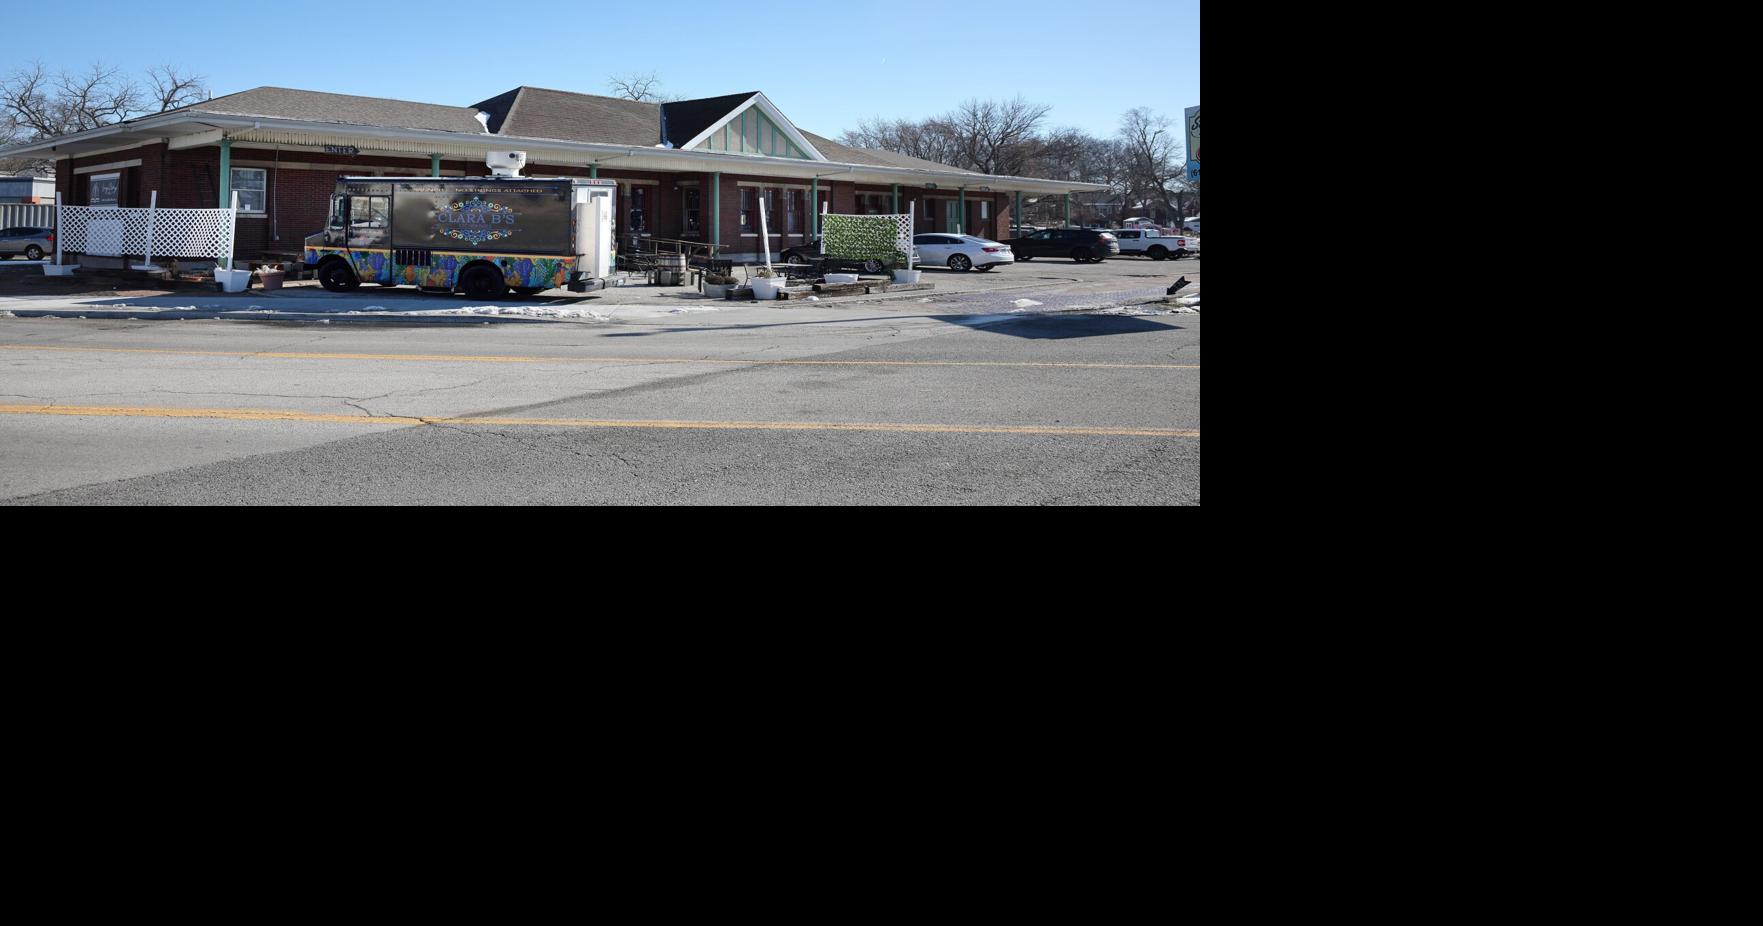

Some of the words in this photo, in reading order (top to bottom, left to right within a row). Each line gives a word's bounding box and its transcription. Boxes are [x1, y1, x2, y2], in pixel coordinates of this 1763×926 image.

[325, 145, 354, 154] ENTER
[437, 213, 486, 223] CLARA
[492, 214, 515, 225] B'S
